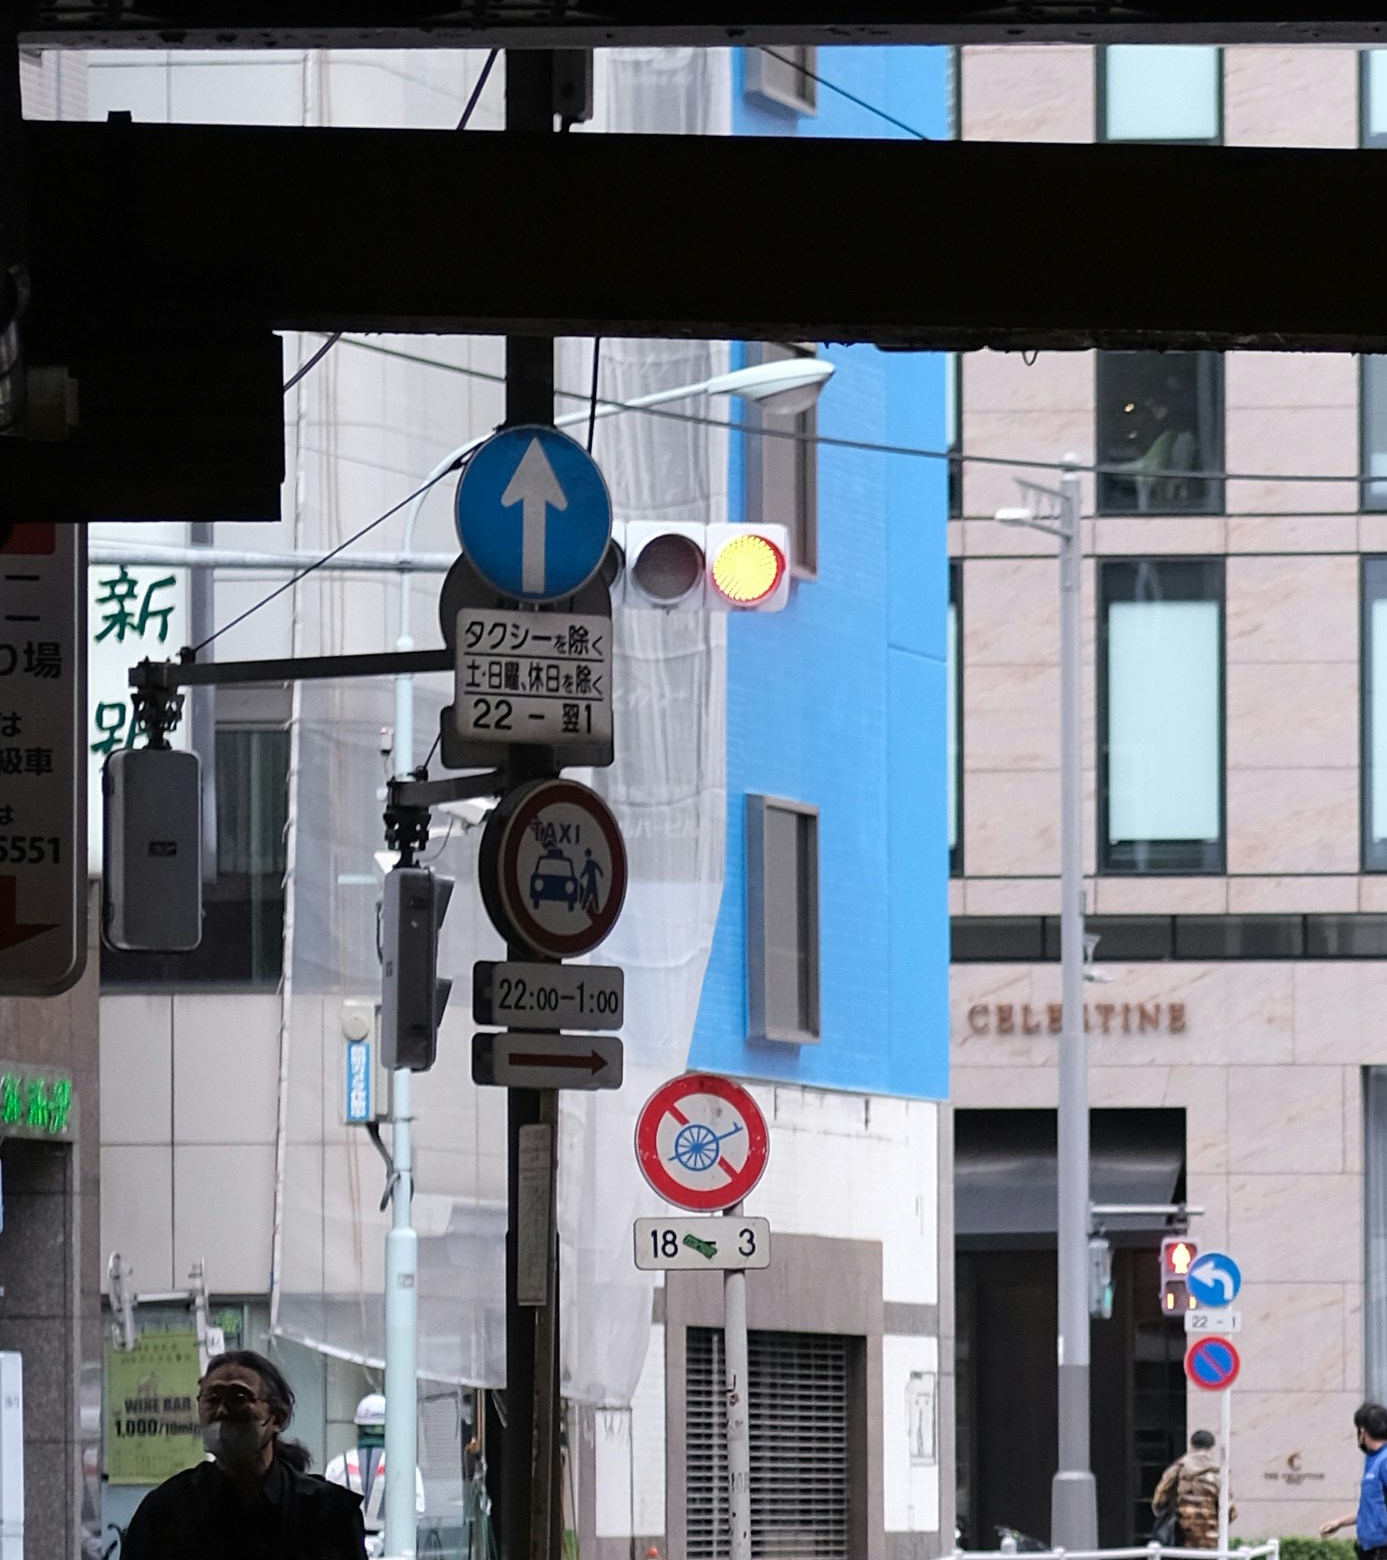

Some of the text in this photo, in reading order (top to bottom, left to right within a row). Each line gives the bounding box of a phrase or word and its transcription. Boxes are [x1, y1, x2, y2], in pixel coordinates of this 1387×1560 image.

[465, 621, 603, 656] タクシーを除く
[532, 820, 580, 845] TAXI
[651, 1229, 679, 1258] 18
[738, 1228, 756, 1257] 3
